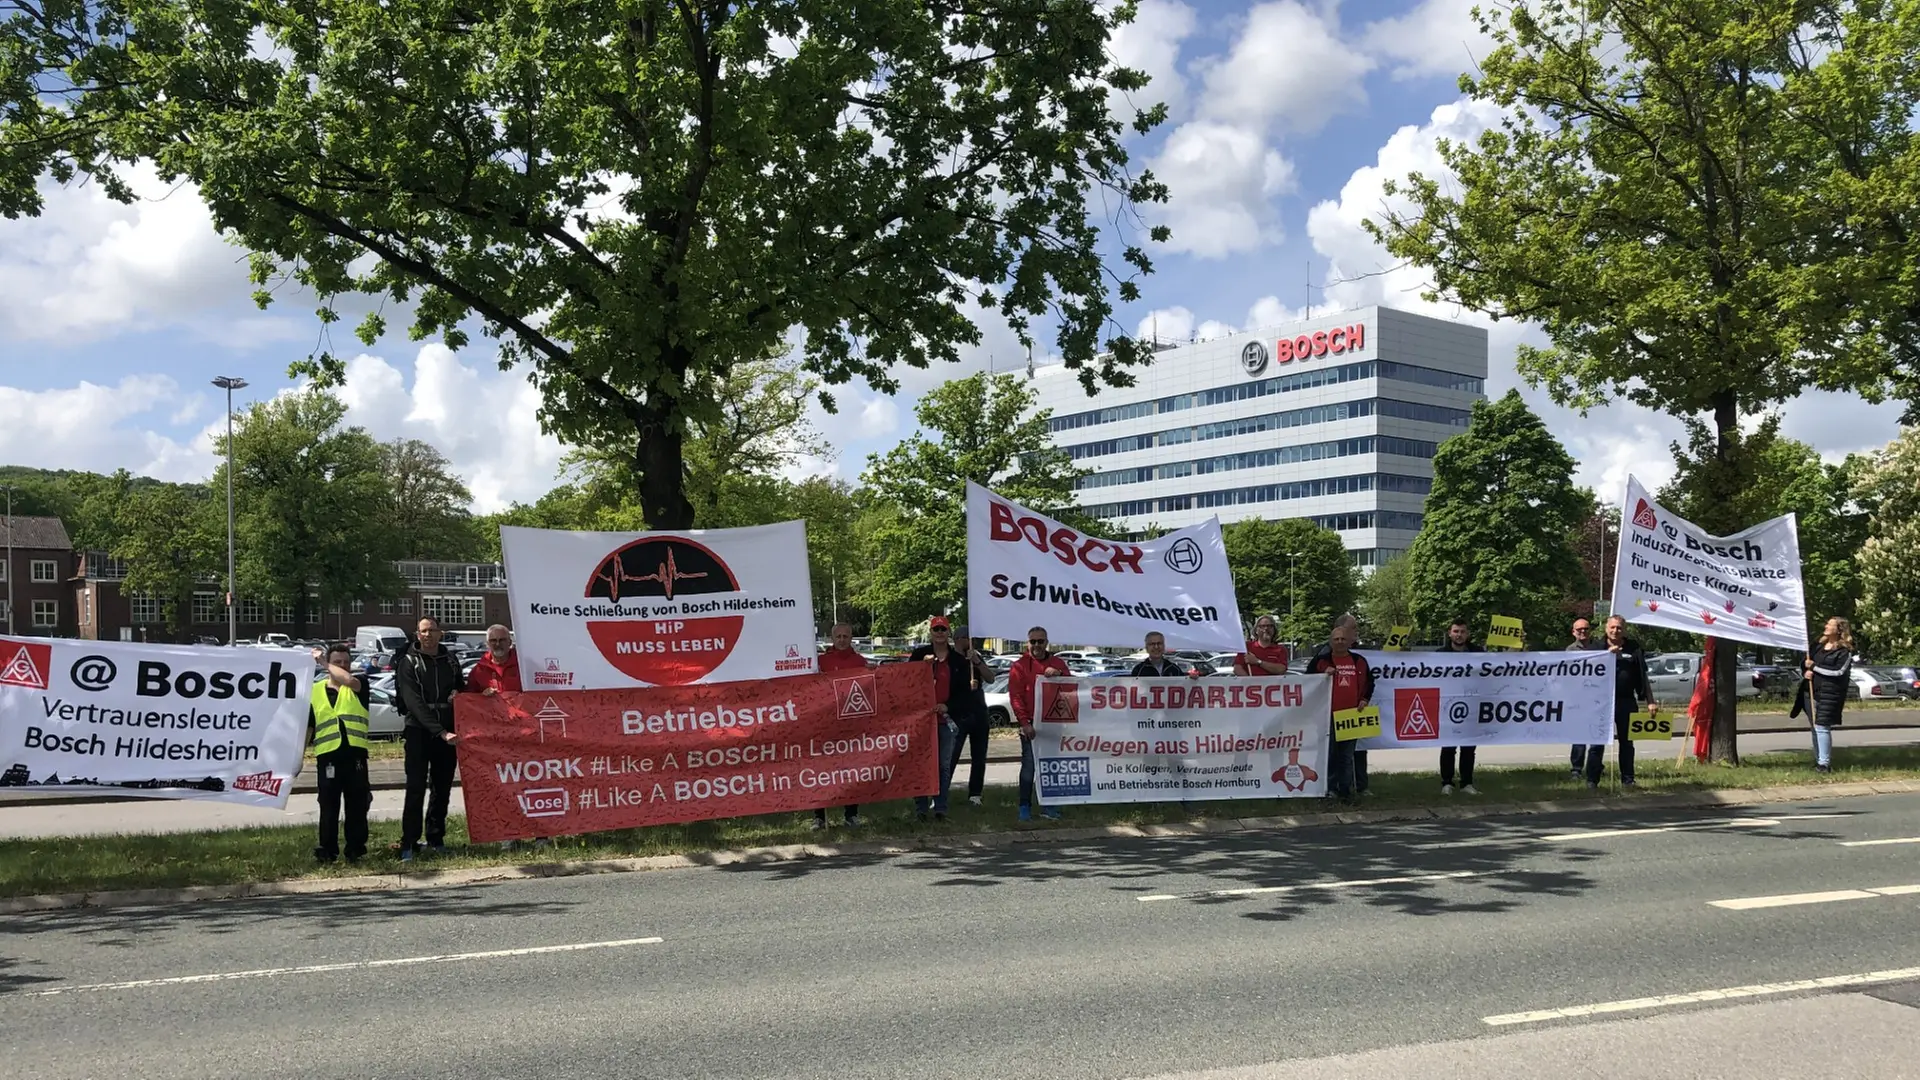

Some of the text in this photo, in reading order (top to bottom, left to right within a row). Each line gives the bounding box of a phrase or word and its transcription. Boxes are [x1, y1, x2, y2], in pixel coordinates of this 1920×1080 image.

[1277, 324, 1364, 363] BOSCH
[989, 500, 1144, 574] BOSCH
[1684, 533, 1762, 561] Bosch
[1631, 530, 1786, 579] Industriearbeitsplätze
[1631, 552, 1752, 597] für unsere Kinder
[989, 574, 1218, 625] Schwieberdingen
[1631, 579, 1689, 603] erhalten
[530, 597, 796, 618] Keine Schließung von Bosch Hildesheim
[616, 637, 725, 654] MUSS LEBEN
[70, 655, 296, 699] @ Bosch
[1371, 660, 1606, 680] etriebsrat Schillerhöhe
[1091, 684, 1303, 709] SOLIDARISCH
[42, 696, 251, 730] Vertrauensleute
[622, 700, 798, 734] Betriebsrat
[1137, 719, 1201, 729] mit unseren
[1335, 715, 1379, 731] HILFE!
[1449, 700, 1563, 723] @ BOSCH
[1632, 720, 1670, 733] SOS
[24, 727, 259, 761] Bosch Hildesheim
[1060, 731, 1303, 757] Kollegen aus Hildesheim!
[496, 731, 909, 784] WORK #Like A BOSCH in Leonberg
[1040, 761, 1087, 773] BOSCH
[1106, 763, 1253, 776] Die Kollegen, Vertrauensleute
[579, 763, 895, 809] #Like A BOSCH in Germany
[1041, 774, 1087, 786] BLEIBT
[1097, 779, 1117, 790] und
[1119, 778, 1180, 790] Betriebsräte
[1183, 778, 1212, 789] Bosch
[1215, 777, 1261, 790] Homburg
[527, 797, 562, 810] Lose
